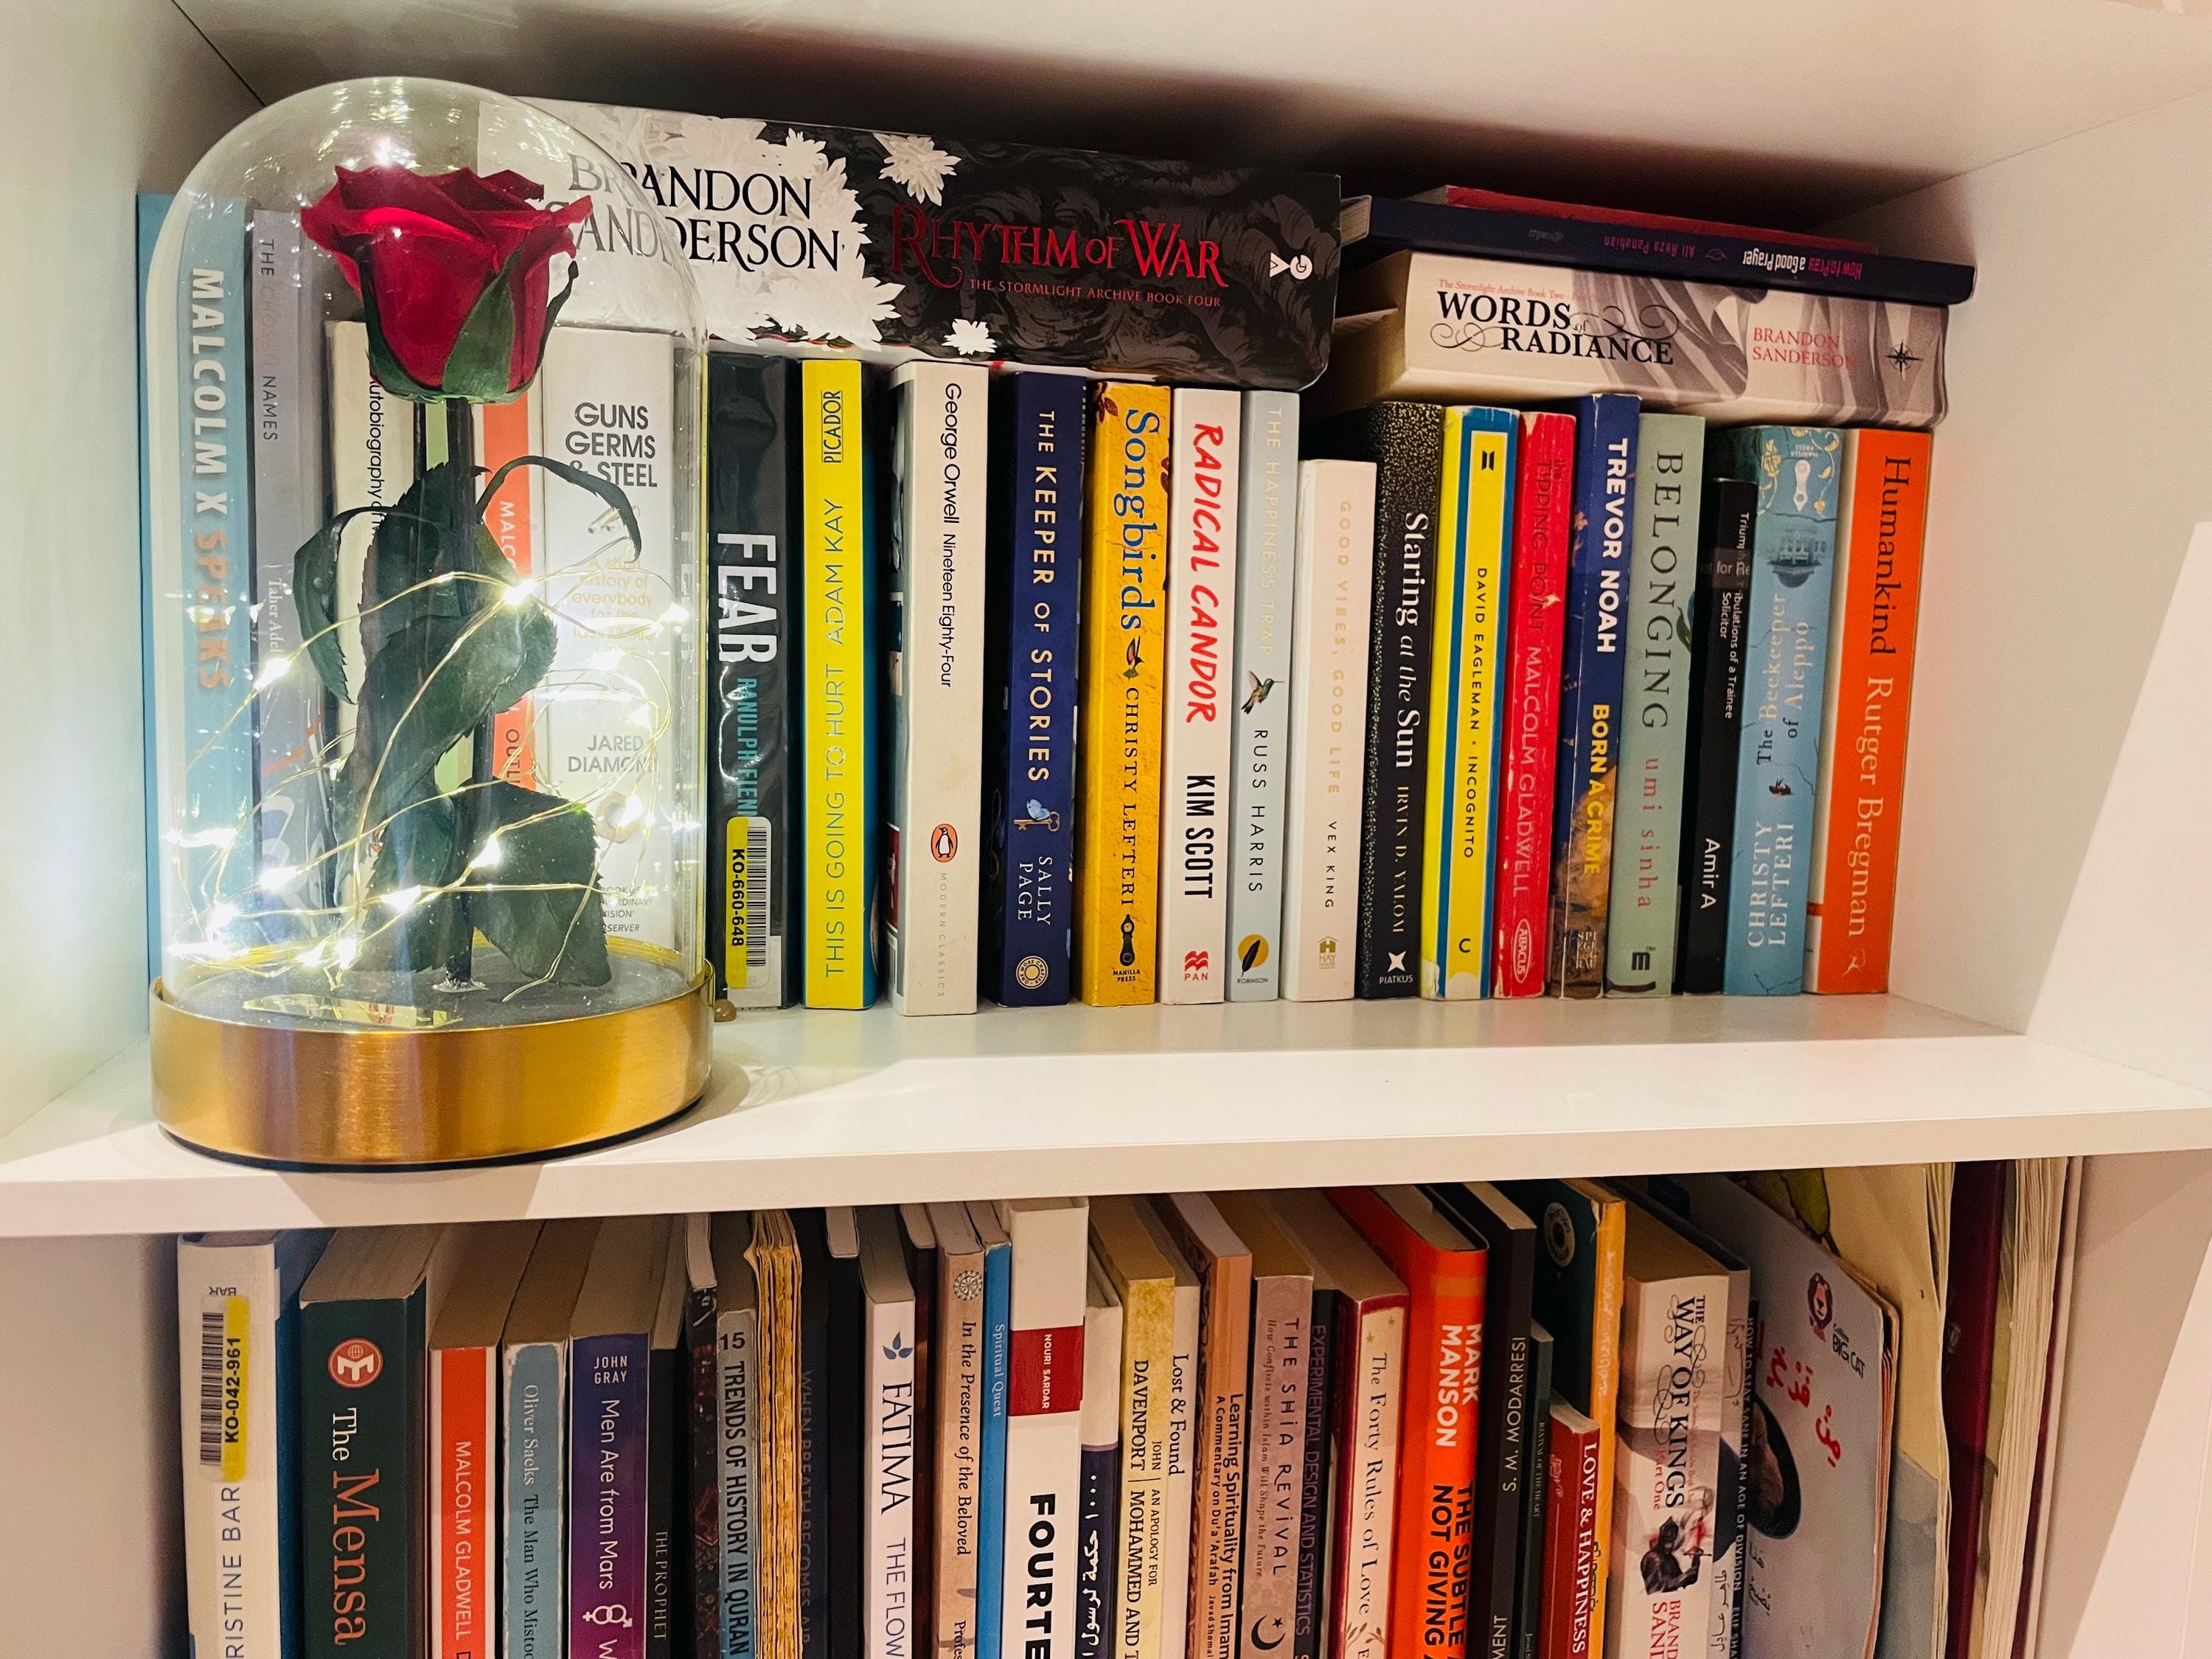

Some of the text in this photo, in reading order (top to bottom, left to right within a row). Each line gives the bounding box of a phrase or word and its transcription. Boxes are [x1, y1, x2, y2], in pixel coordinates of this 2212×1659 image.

[970, 279, 1222, 307] THE STORMLIGHT ARCHIVE BOOK FOUR
[1742, 248, 1799, 274] Good Prayer
[191, 268, 228, 515] MALCOLM X
[1437, 291, 1674, 365] WORDS RADIANCE
[262, 376, 279, 440] NAMES
[566, 431, 655, 459] GERMS
[574, 402, 649, 430] GUNS
[822, 389, 843, 464] PICADOR
[824, 499, 845, 645] ADAM KAY
[939, 383, 963, 688] George Orwell Nineteen Eighty-Four
[1113, 408, 1161, 631] Songbirds
[1186, 423, 1225, 724] RADICAL CANDOR
[1259, 461, 1281, 655] HAPPINESS TRAP
[1596, 437, 1627, 653] TREVOR NOAH
[717, 532, 778, 664] FEAR
[1027, 410, 1057, 782] THE KEEPER OF STORIES
[1395, 512, 1430, 770] Staring at the Sun
[1641, 451, 1683, 728] BELONGING
[1464, 568, 1488, 859] DAVID EAGLEMAN INCOGNITO
[1756, 592, 1790, 765] The Beekeeper
[1783, 622, 1815, 739] of Aleppo
[1848, 455, 1911, 937] Humankind Rutger Bregman
[826, 663, 846, 978] THIS IS GOING TO HURT
[1120, 686, 1140, 906] CHRISTY LEFTERI
[1184, 775, 1216, 899] KIM SCOTT
[1248, 729, 1268, 892] RUSS HARRIS
[1513, 646, 1542, 897] MALCOLM GLADWELL
[1583, 703, 1610, 875] BORN A CRIME
[1637, 757, 1663, 908] umi sinha
[731, 848, 745, 947] KO-660-648
[1018, 863, 1033, 922] PAGE
[1037, 855, 1053, 926] SALLY
[1324, 821, 1338, 908] VEX KING
[1700, 838, 1721, 910] Amir A
[1747, 821, 1773, 948] CHRISTY
[1768, 823, 1795, 947] LEFTERI
[936, 872, 948, 998] MODERN CLASSICS
[1184, 973, 1208, 982] PAN
[1379, 973, 1413, 985] PIATKUS
[1515, 928, 1527, 975] ABACUS
[224, 1338, 241, 1443] KO-042-961
[594, 1355, 629, 1370] JOHN
[594, 1370, 628, 1385] GRAY
[719, 1332, 746, 1351] 15
[991, 1324, 1006, 1418] Spiritual Quest
[1042, 1333, 1052, 1411] NOURI SARDAR
[1436, 1325, 1463, 1447] MANSON
[1461, 1324, 1484, 1405] MARK
[1665, 1295, 1695, 1508] WAY OF KINGS
[881, 1381, 914, 1516] FATIMA
[955, 1321, 977, 1556] In the Presence of the Beloved
[1130, 1360, 1150, 1472] DAVENPORT
[1152, 1441, 1162, 1470] JOHN
[1169, 1354, 1189, 1477] Lost & Found
[1503, 1337, 1527, 1491] S. M. MODARRESI
[331, 1408, 380, 1646] The Mensa
[455, 1441, 473, 1641] MALCOLM GLADWELL
[523, 1384, 540, 1606] Oliver Sacks The Man Who
[599, 1399, 621, 1590] Men Are from Mars
[724, 1360, 750, 1656] TRENDS OF HISTORY IN QURAN
[1149, 1489, 1161, 1587] AN APOLOGY FOR
[1220, 1394, 1243, 1610] Learning Spirituality from
[1295, 1326, 1326, 1635] EXPERIMENTAL DESIGN AND STATISTICS
[1359, 1352, 1388, 1615] The Forty Rules of Love
[653, 1531, 668, 1640] THE PROPHET
[1125, 1490, 1145, 1646] MOHAMMED AND
[1571, 1442, 1597, 1654] LOVE & HAPPINESS
